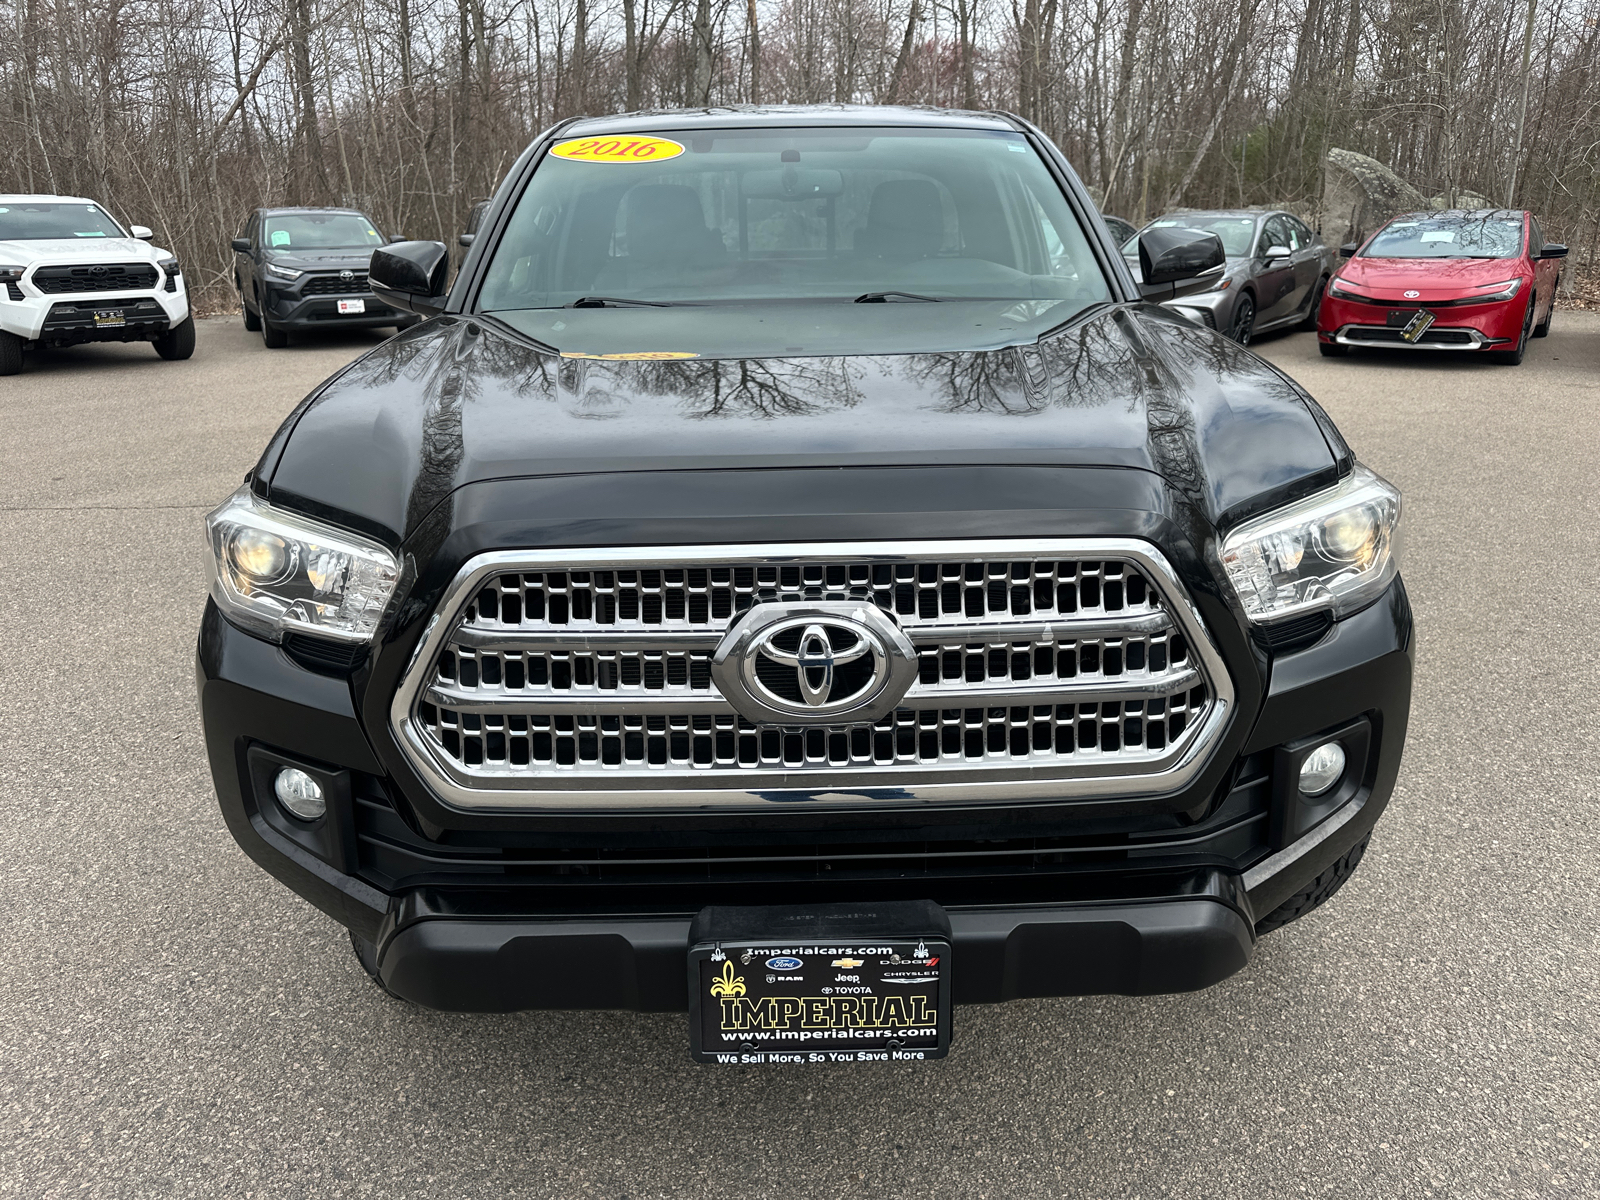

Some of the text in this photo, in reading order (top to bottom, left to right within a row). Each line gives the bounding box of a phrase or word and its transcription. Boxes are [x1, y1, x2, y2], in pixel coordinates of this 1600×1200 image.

[568, 141, 665, 157] 2016
[746, 946, 893, 956] Imperialcars.com
[773, 959, 795, 968] Ford
[834, 973, 860, 984] Jeep
[834, 986, 873, 994] TOYOTA
[720, 995, 937, 1030] IMPERIAL
[720, 1028, 937, 1041] www.imperialcars.com
[717, 1051, 925, 1064] We Sell More, So You Save More
